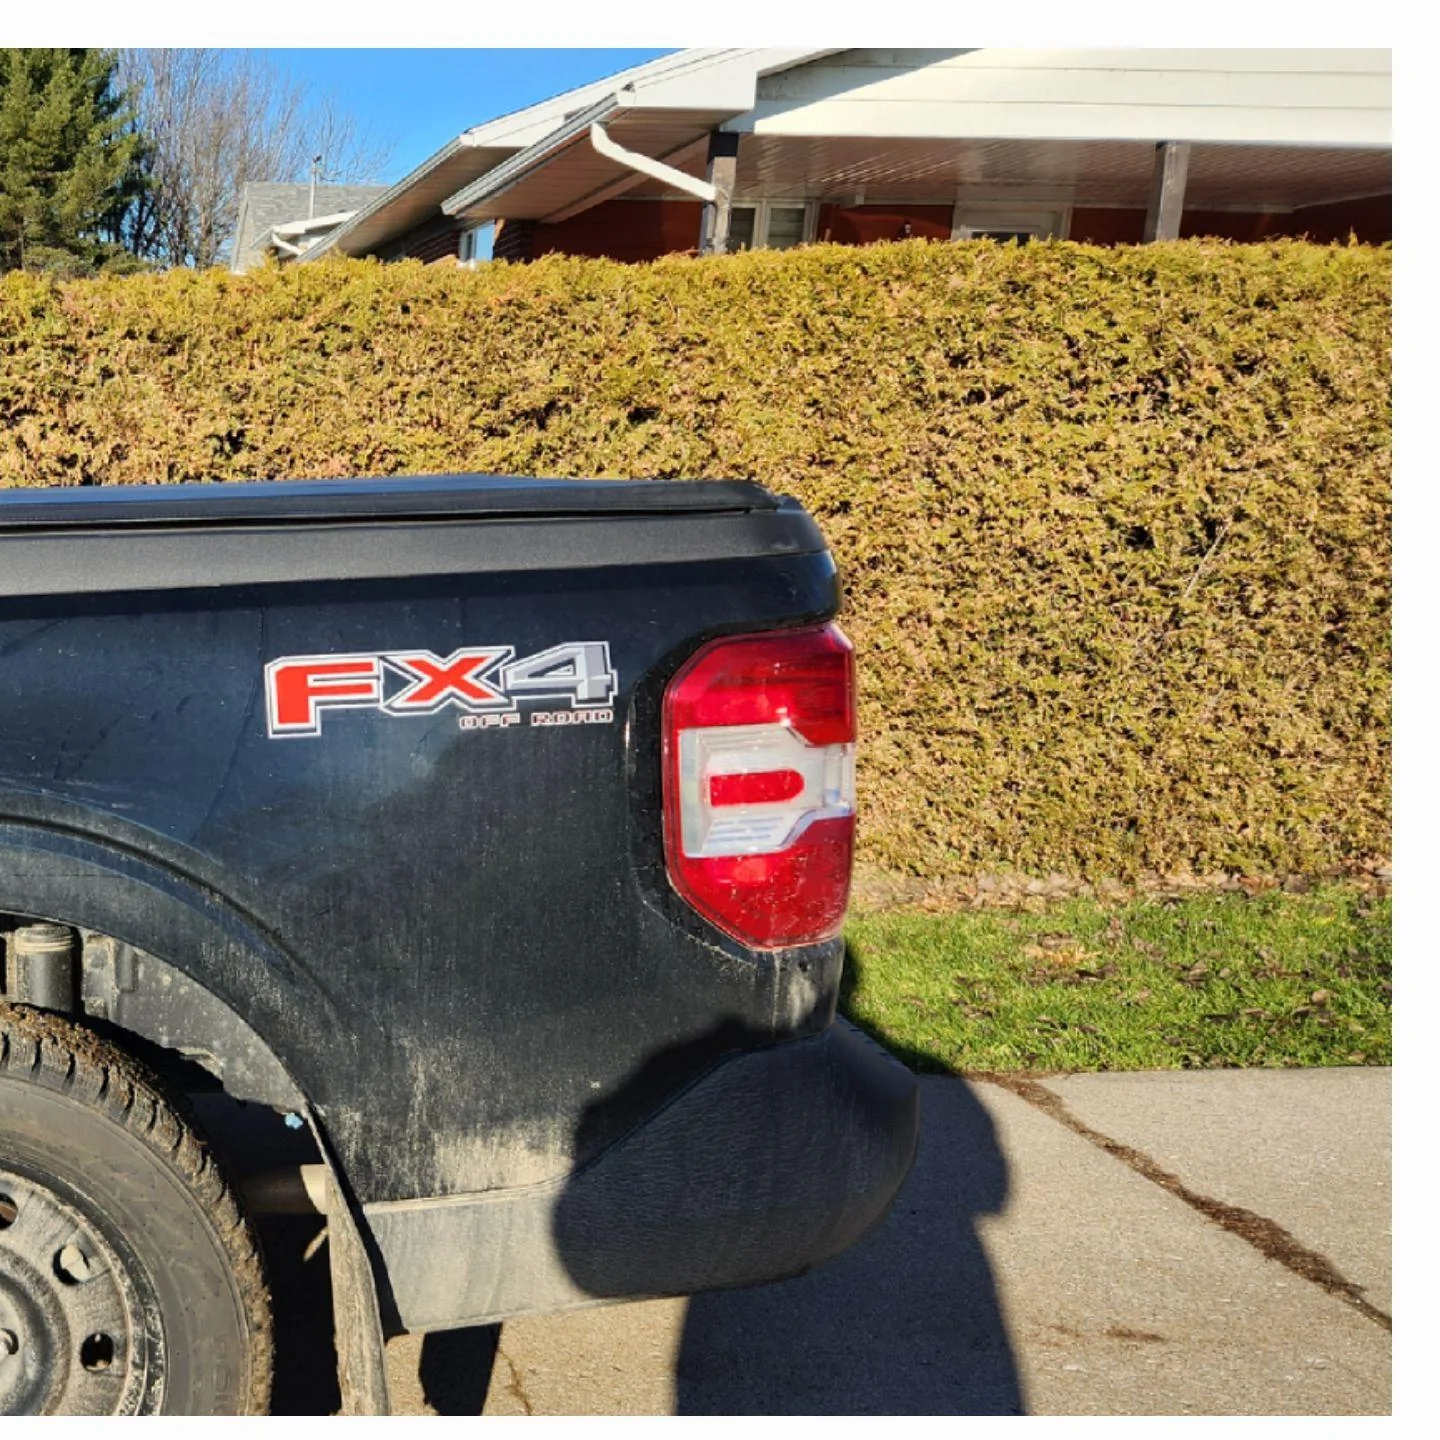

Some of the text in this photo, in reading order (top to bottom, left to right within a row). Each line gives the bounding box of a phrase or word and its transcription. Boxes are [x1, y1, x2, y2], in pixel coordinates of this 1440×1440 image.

[265, 641, 618, 739] FX4
[460, 710, 614, 730] OFF ROAD
